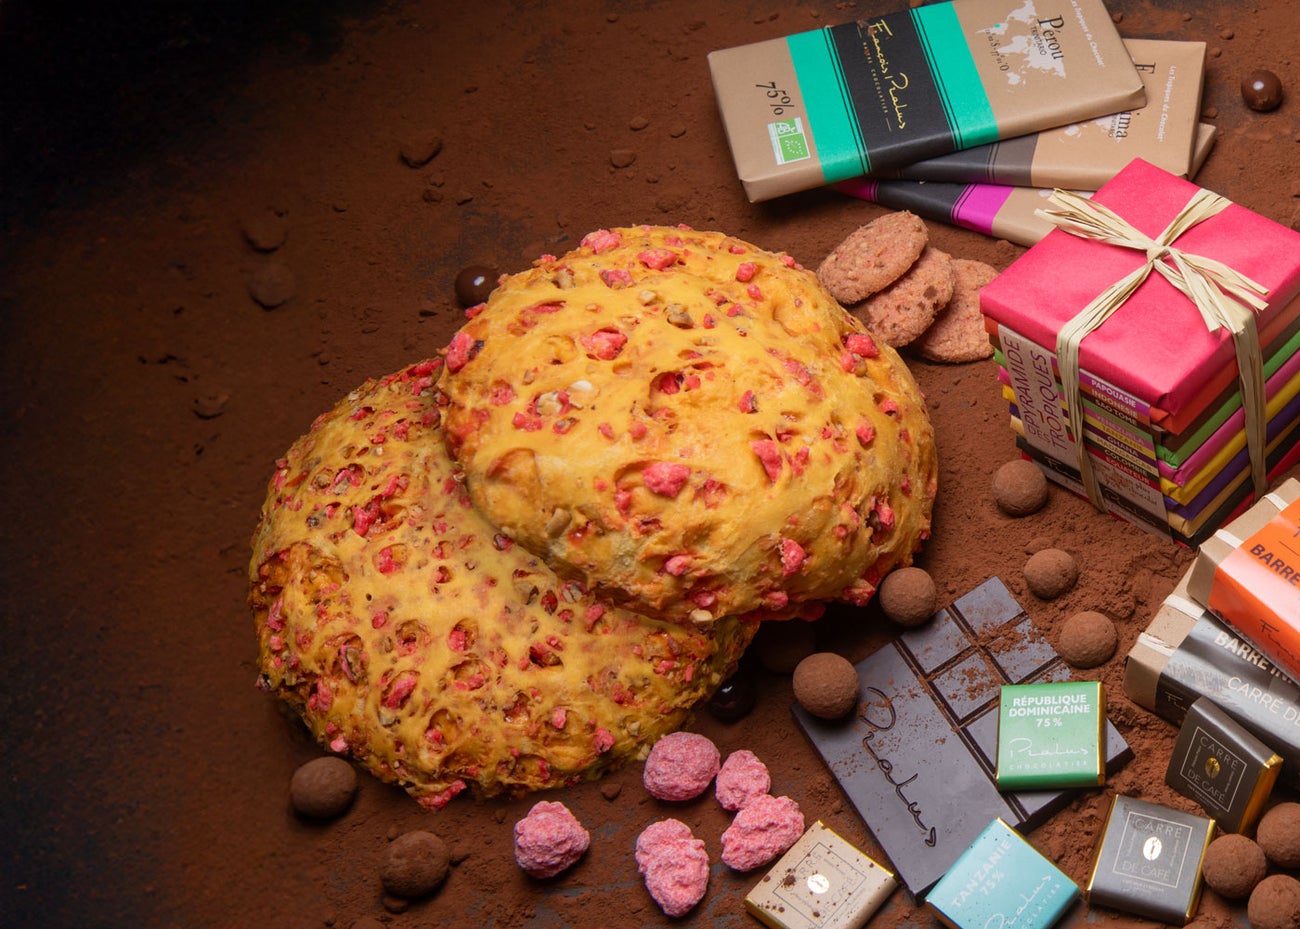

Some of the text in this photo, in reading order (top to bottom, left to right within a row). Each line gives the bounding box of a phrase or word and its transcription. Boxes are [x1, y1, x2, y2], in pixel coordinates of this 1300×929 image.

[1031, 26, 1047, 56] TRINITARIO
[1037, 15, 1064, 60] Pérou
[755, 81, 795, 116] 75%
[1003, 336, 1039, 428] PYRAMIDE
[1090, 379, 1136, 408] PAPOUASIE
[1213, 630, 1269, 670] BARRE
[1013, 694, 1086, 706] RÉPUBLIQUE
[1225, 675, 1283, 712] CARRÉ
[1008, 704, 1090, 716] DOMINICAINE
[1009, 738, 1088, 757] Pralus
[1198, 735, 1239, 769] CARRÉ
[1009, 760, 1086, 769] CHOCOLATIER
[1186, 769, 1201, 784] DE
[1200, 780, 1225, 803] CAFÉ
[1134, 818, 1182, 838] CARRÉ
[951, 838, 1012, 909] TANZANIE
[1121, 861, 1169, 880] DE CAFÉ
